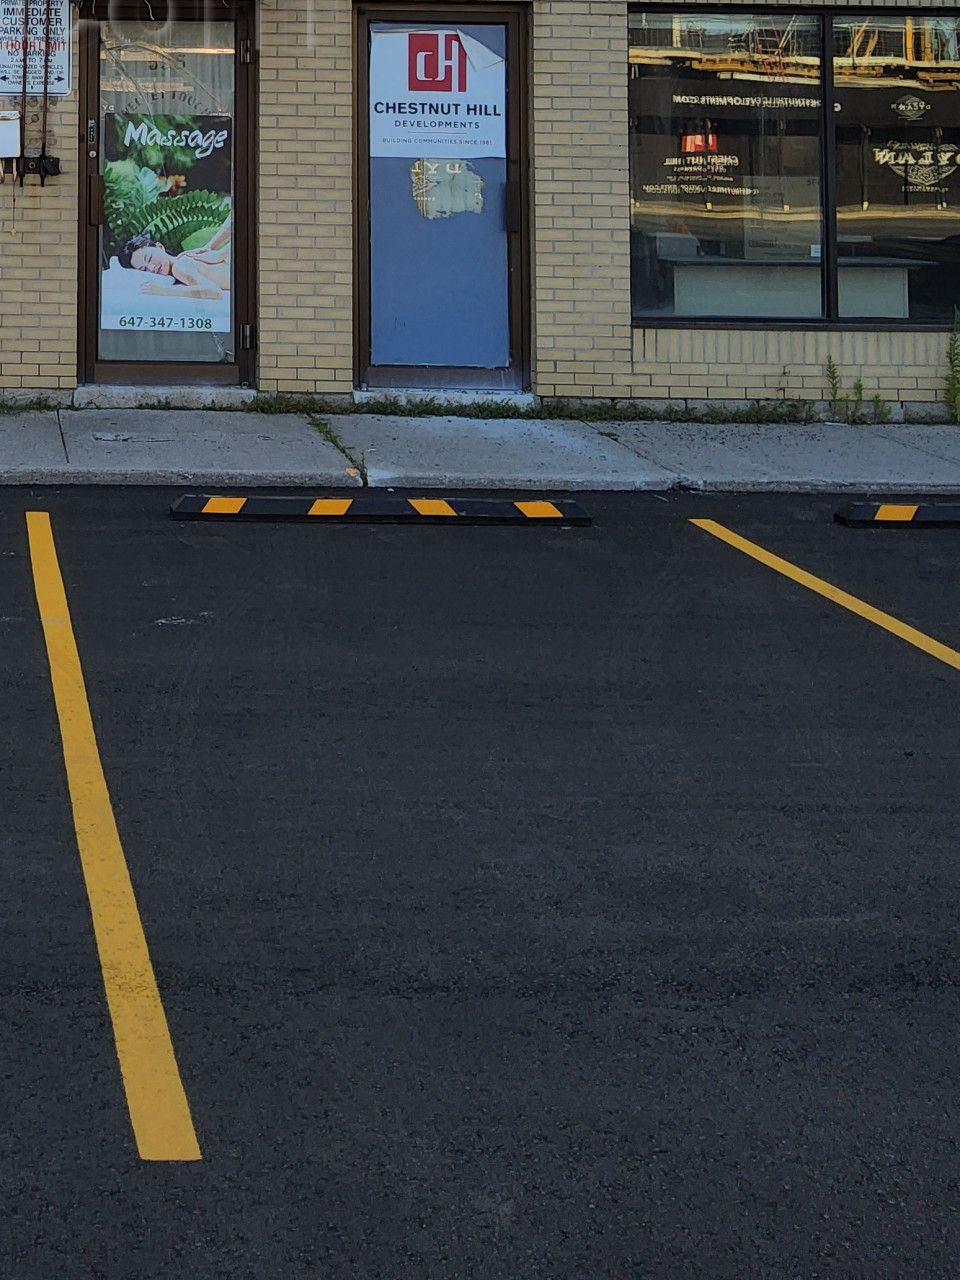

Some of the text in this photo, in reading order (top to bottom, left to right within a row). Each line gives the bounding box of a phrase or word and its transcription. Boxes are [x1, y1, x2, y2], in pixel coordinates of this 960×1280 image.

[3, 7, 61, 17] IMMEDIATE
[2, 17, 62, 26] CUSTOMER
[42, 26, 66, 36] ONLY
[6, 40, 36, 51] HOR
[38, 41, 67, 52] LMIT
[373, 101, 502, 117] CHESTNUT HILL
[394, 120, 480, 129] DEVELOPMENTS
[124, 121, 228, 159] Massage
[119, 316, 213, 329] 647-347-1308
